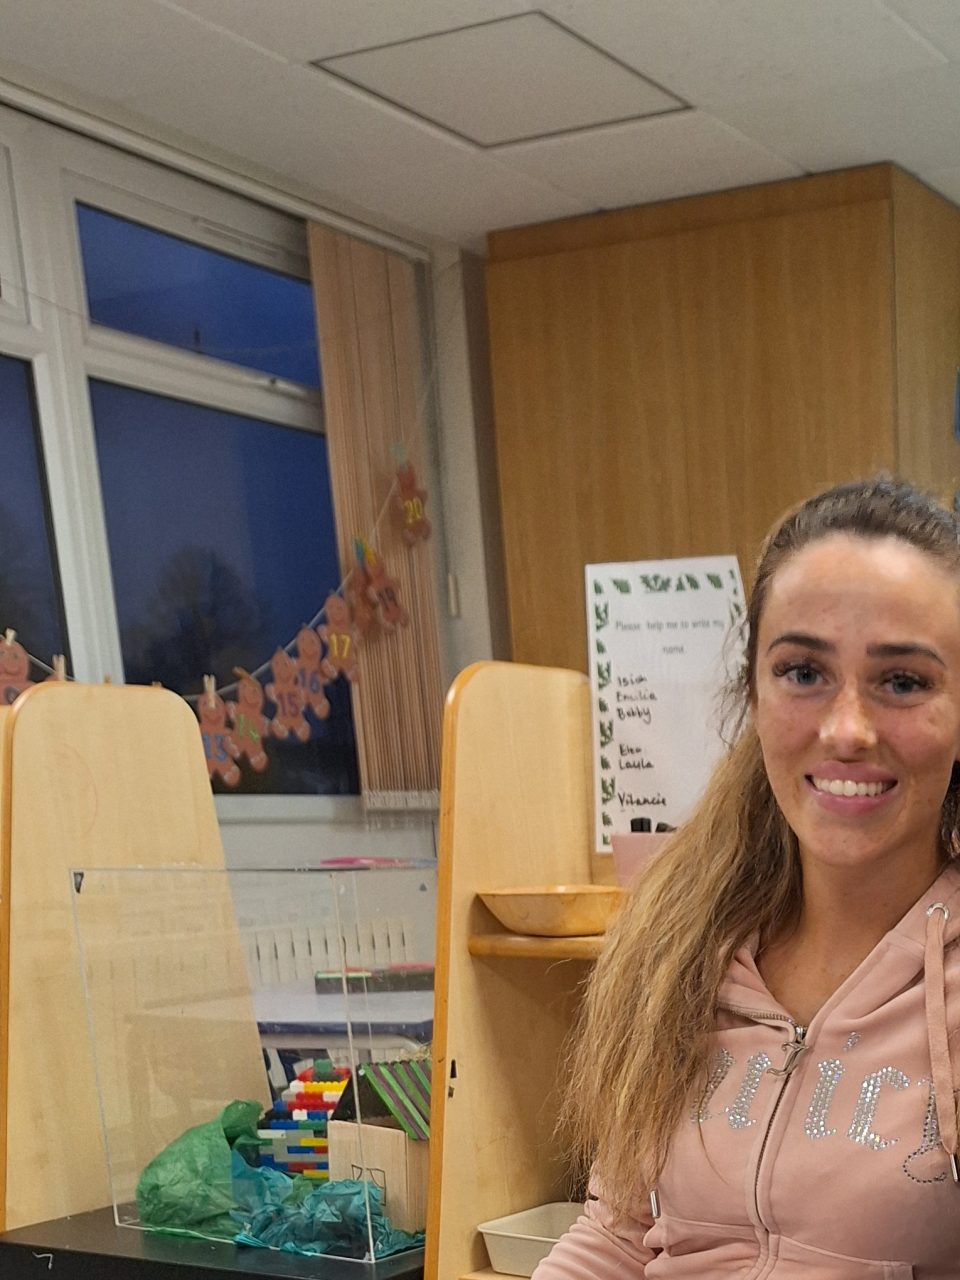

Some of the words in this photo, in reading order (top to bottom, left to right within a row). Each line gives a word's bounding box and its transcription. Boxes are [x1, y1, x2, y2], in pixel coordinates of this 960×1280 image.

[616, 621, 640, 631] Please
[647, 621, 664, 632] help
[666, 621, 678, 629] me
[681, 621, 689, 629] to
[691, 620, 710, 629] write
[330, 632, 350, 659] 17
[278, 692, 299, 718] 15
